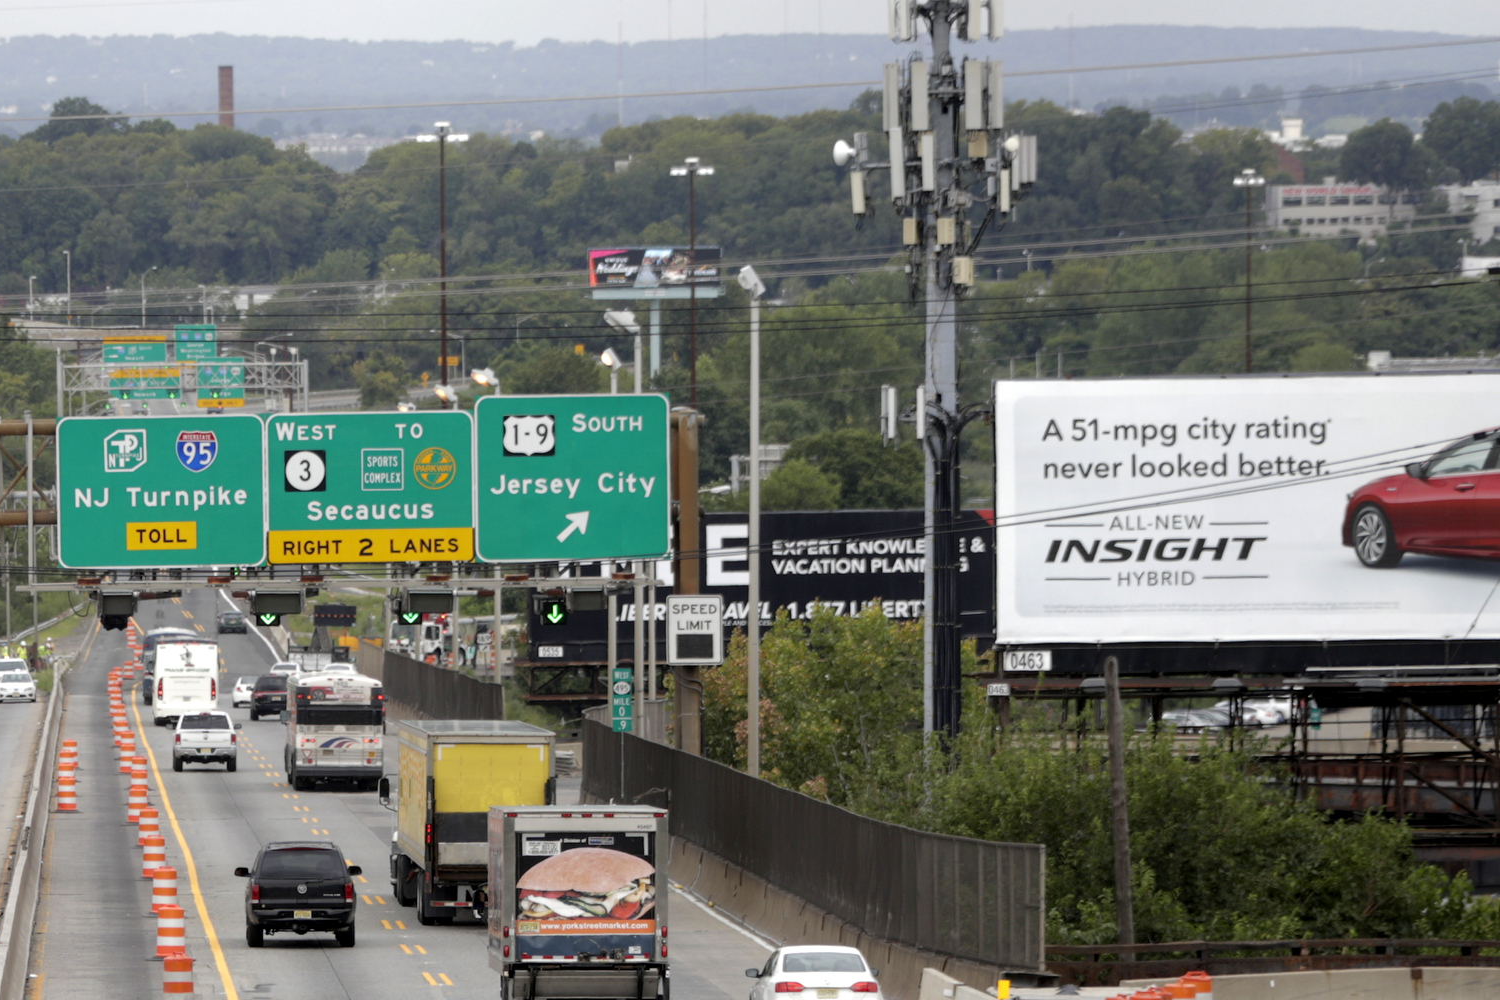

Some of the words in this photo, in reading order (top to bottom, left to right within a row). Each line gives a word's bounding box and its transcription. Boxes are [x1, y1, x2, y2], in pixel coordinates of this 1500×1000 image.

[275, 422, 336, 441] WEST
[395, 422, 423, 439] TO
[572, 413, 643, 433] SOUTH
[513, 424, 548, 446] 1-9
[1042, 419, 1063, 441] A
[1071, 418, 1177, 447] 51-mpg
[1187, 417, 1236, 446] city
[183, 442, 212, 465] 95
[367, 456, 398, 467] SPORTS
[299, 460, 311, 482] 3
[415, 465, 453, 473] PARKWAY
[1043, 461, 1122, 479] never
[1131, 454, 1227, 478] looked
[1238, 453, 1330, 478] better.
[364, 472, 401, 484] COMPLEX
[490, 474, 581, 499] Jersey
[598, 471, 656, 498] City
[75, 487, 109, 508] NJ
[126, 485, 248, 511] Turnpike
[307, 500, 434, 521] Secaucus
[1109, 515, 1204, 531] ALL-NEW
[136, 529, 187, 543] TOLL
[283, 540, 342, 555] RIGHT
[359, 538, 373, 556] 2
[390, 538, 459, 553] LANES
[771, 539, 839, 556] EXPERT
[970, 537, 986, 553] &
[1044, 537, 1268, 563] INSIGHT
[772, 558, 866, 575] VACATION
[871, 556, 970, 574] PLANG
[1117, 571, 1195, 587] HYBRID
[672, 604, 717, 615] SPEED
[677, 620, 712, 631] LIMIT
[1010, 652, 1044, 669] 0463
[614, 671, 629, 679] WEST
[615, 684, 629, 692] 495
[988, 685, 1009, 695] 0463
[614, 697, 630, 705] MILE
[619, 708, 625, 716] 0
[540, 922, 648, 931] www.yorkstreetmarket.com
